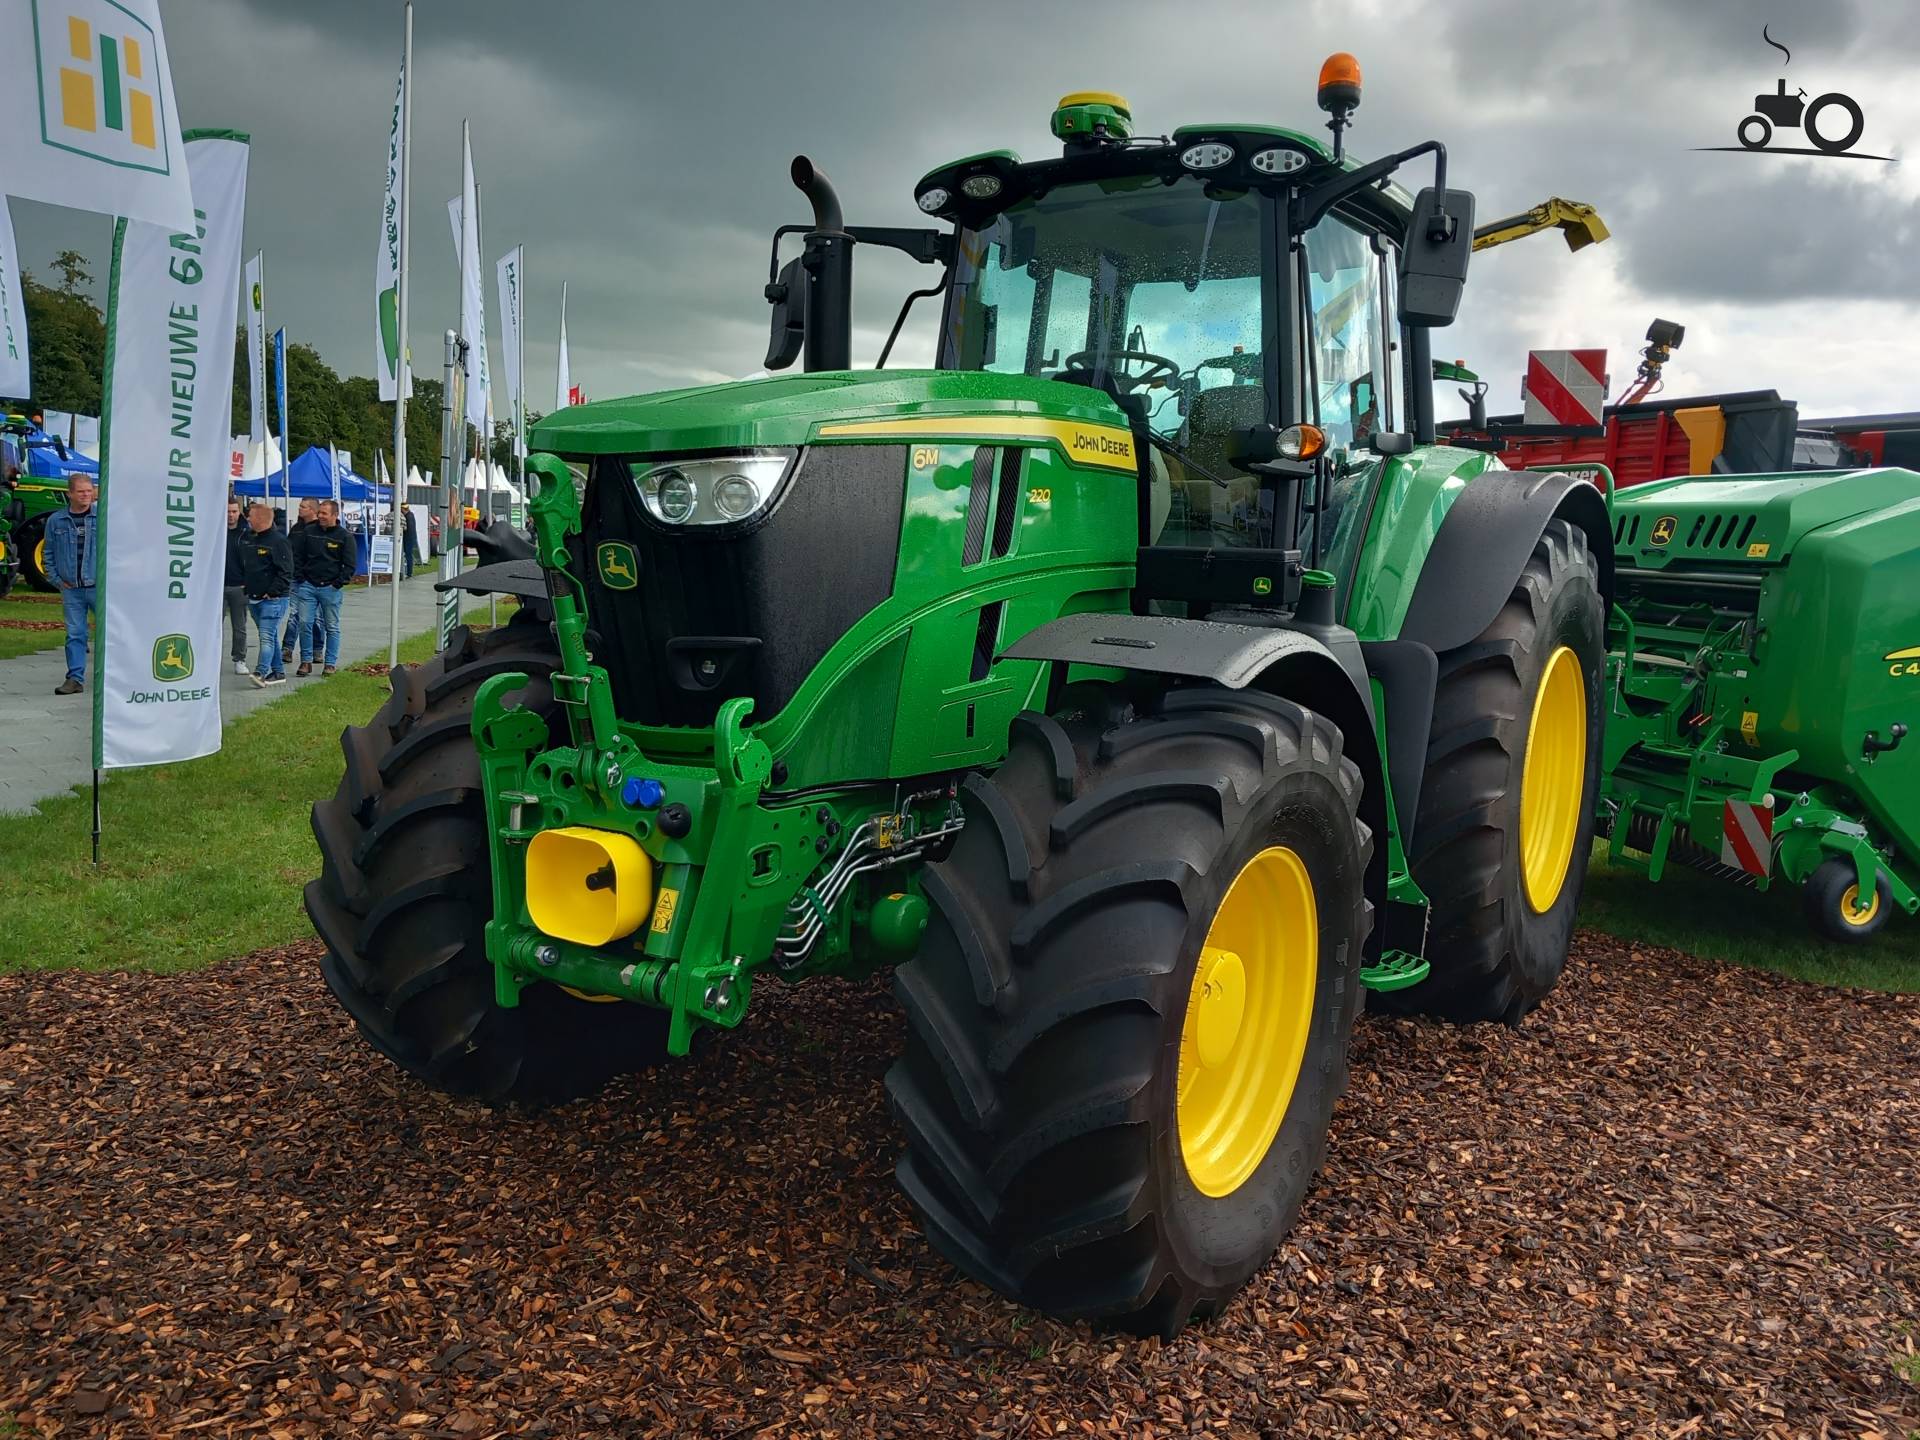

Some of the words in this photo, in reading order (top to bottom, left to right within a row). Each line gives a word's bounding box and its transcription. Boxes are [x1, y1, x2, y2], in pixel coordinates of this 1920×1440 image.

[168, 302, 199, 439] NIEUWE
[1073, 431, 1099, 452] JOHN
[1101, 436, 1130, 457] DEERE
[913, 448, 938, 470] 6M
[1029, 488, 1051, 503] 220
[166, 448, 195, 599] PRIMEUR
[126, 690, 164, 704] JOHN
[167, 687, 211, 702] DEERE
